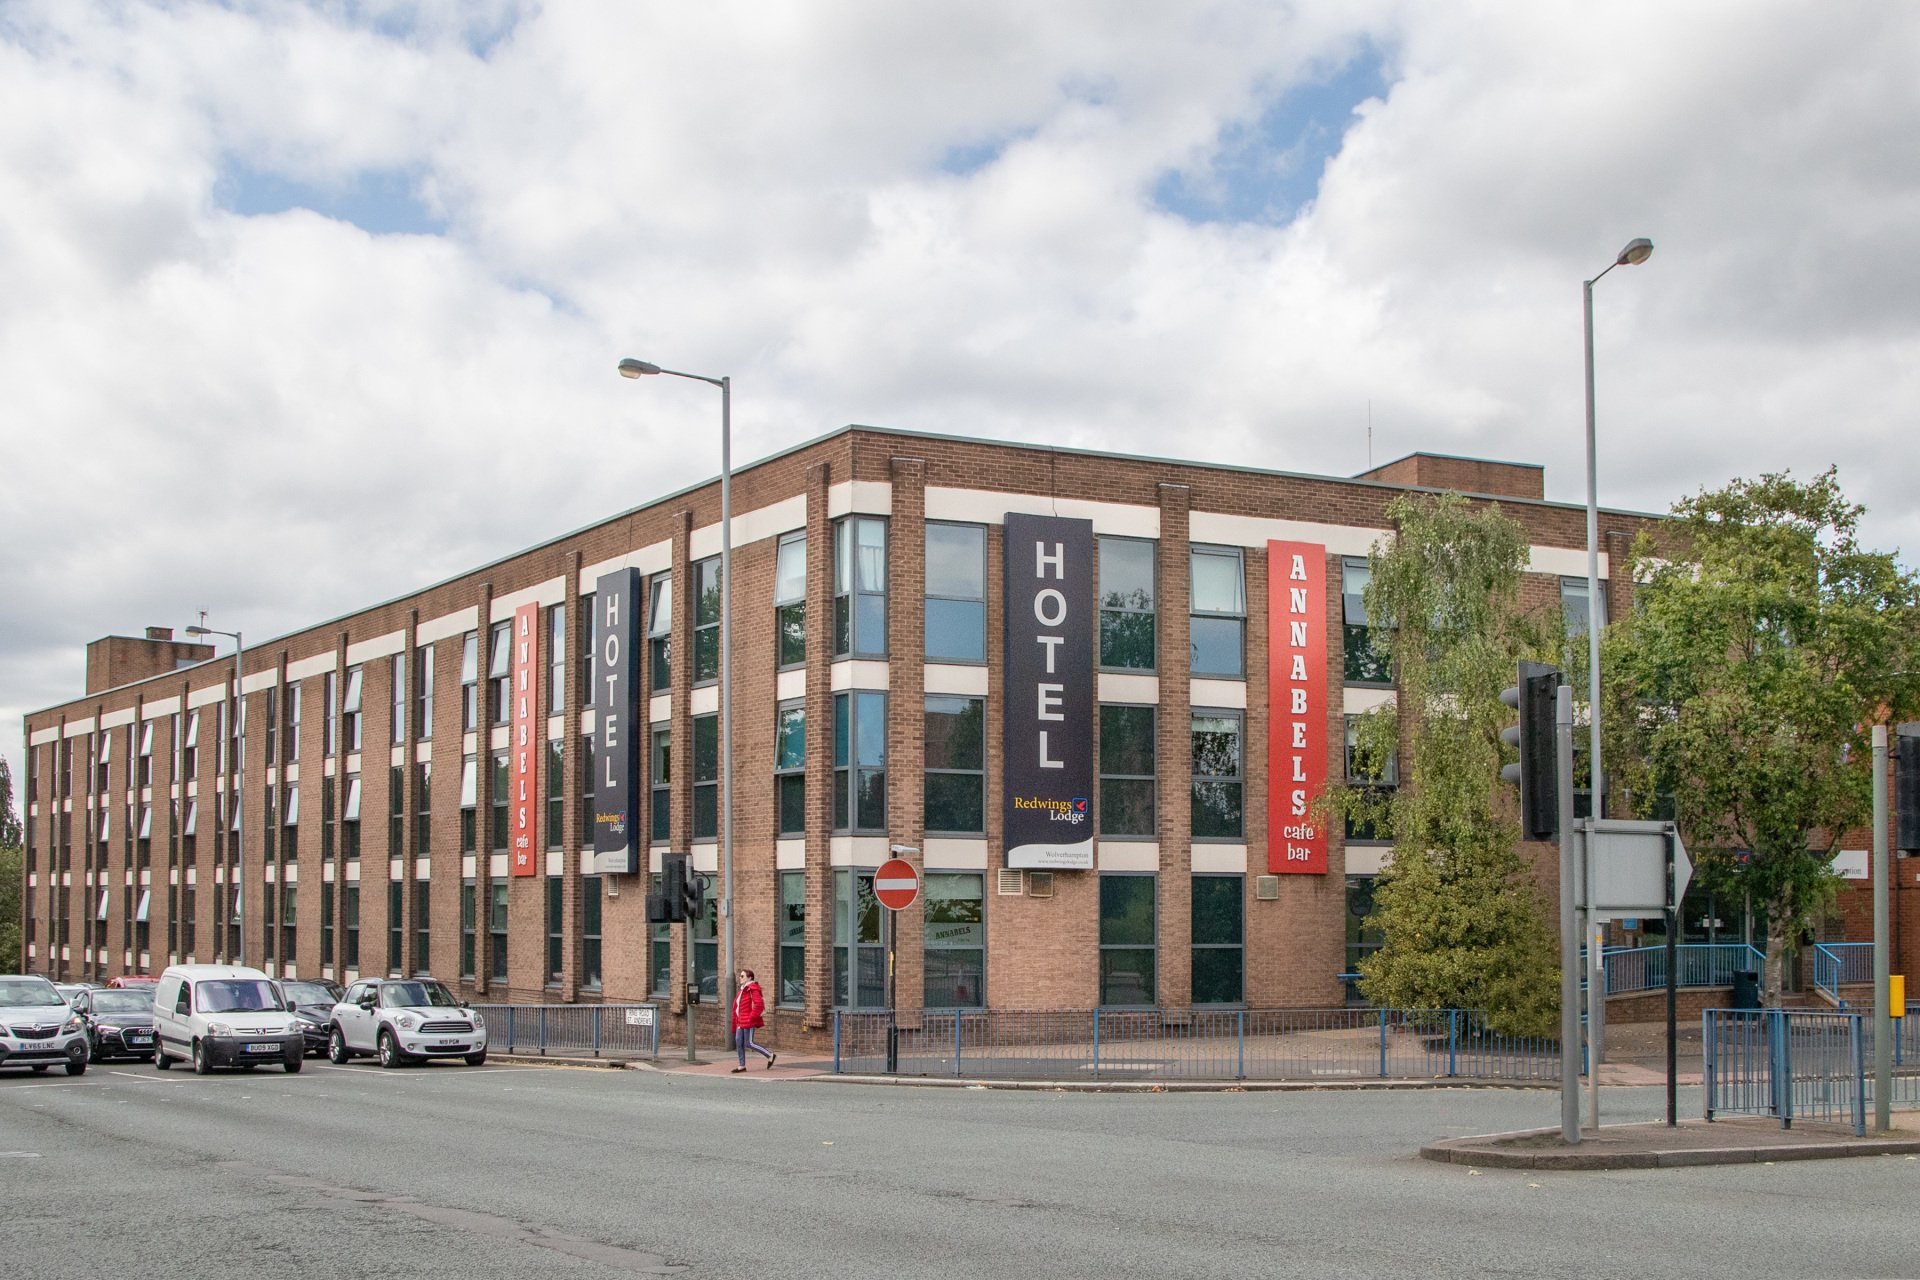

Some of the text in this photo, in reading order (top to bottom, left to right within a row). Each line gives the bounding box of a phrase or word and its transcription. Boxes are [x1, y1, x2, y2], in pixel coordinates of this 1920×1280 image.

[1034, 541, 1067, 769] HOTEL
[605, 593, 620, 788] HOTEL
[1290, 554, 1308, 817] ANNABELS
[519, 615, 529, 829] ANNABELS
[1014, 797, 1072, 813] Redwings
[1050, 810, 1084, 825] Lodge
[610, 822, 625, 834] Lodge
[517, 850, 527, 866] bar
[1045, 851, 1089, 860] Wolverhampton
[1287, 842, 1312, 861] bar
[935, 926, 971, 940] ANNABELS
